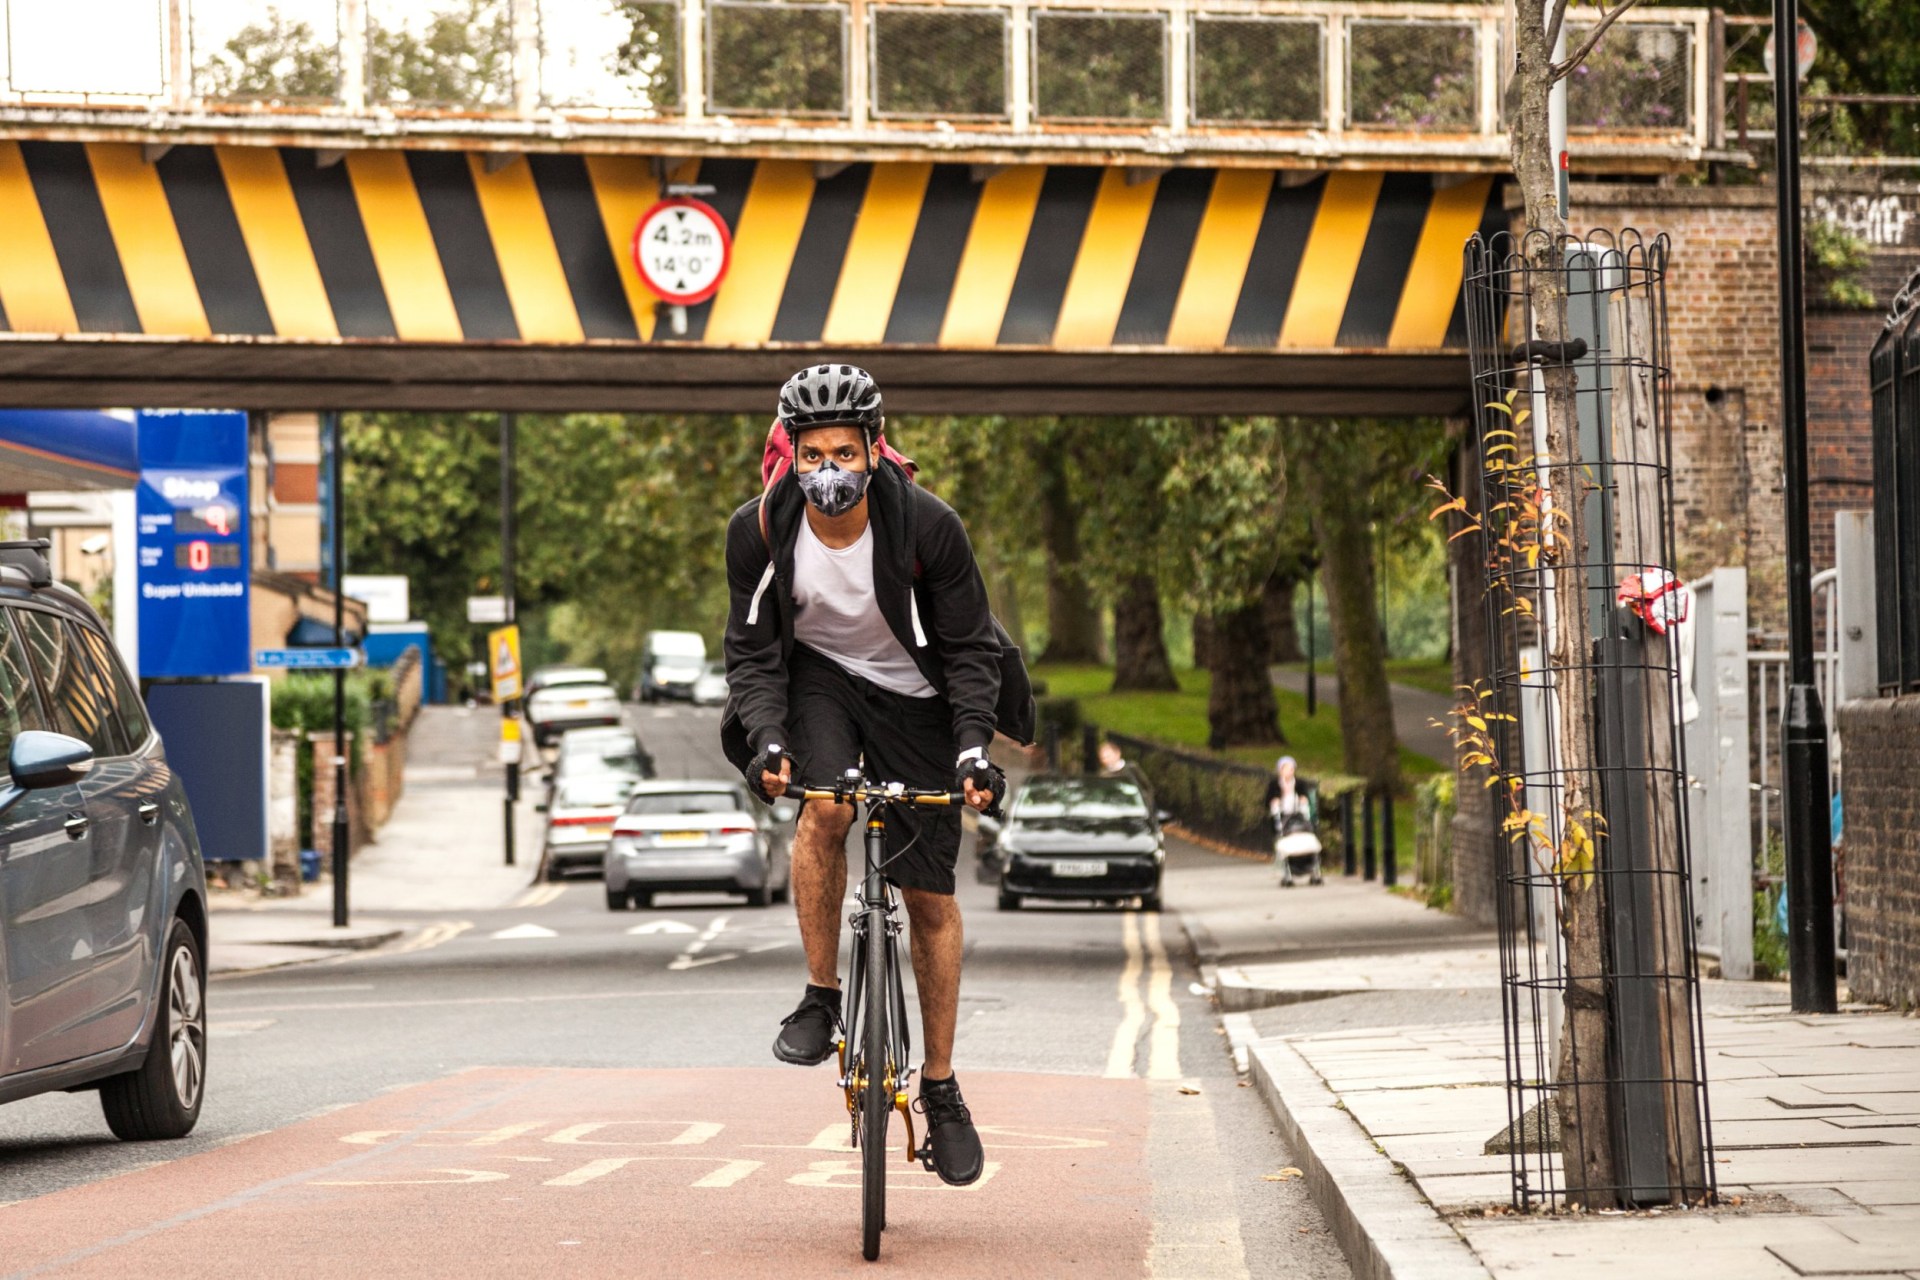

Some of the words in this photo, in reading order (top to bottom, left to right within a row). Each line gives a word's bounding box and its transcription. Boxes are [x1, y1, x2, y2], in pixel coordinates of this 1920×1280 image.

[653, 224, 713, 246] 4.2m
[163, 477, 220, 501] Shop
[142, 582, 181, 600] Super
[182, 582, 244, 598] Unleaded
